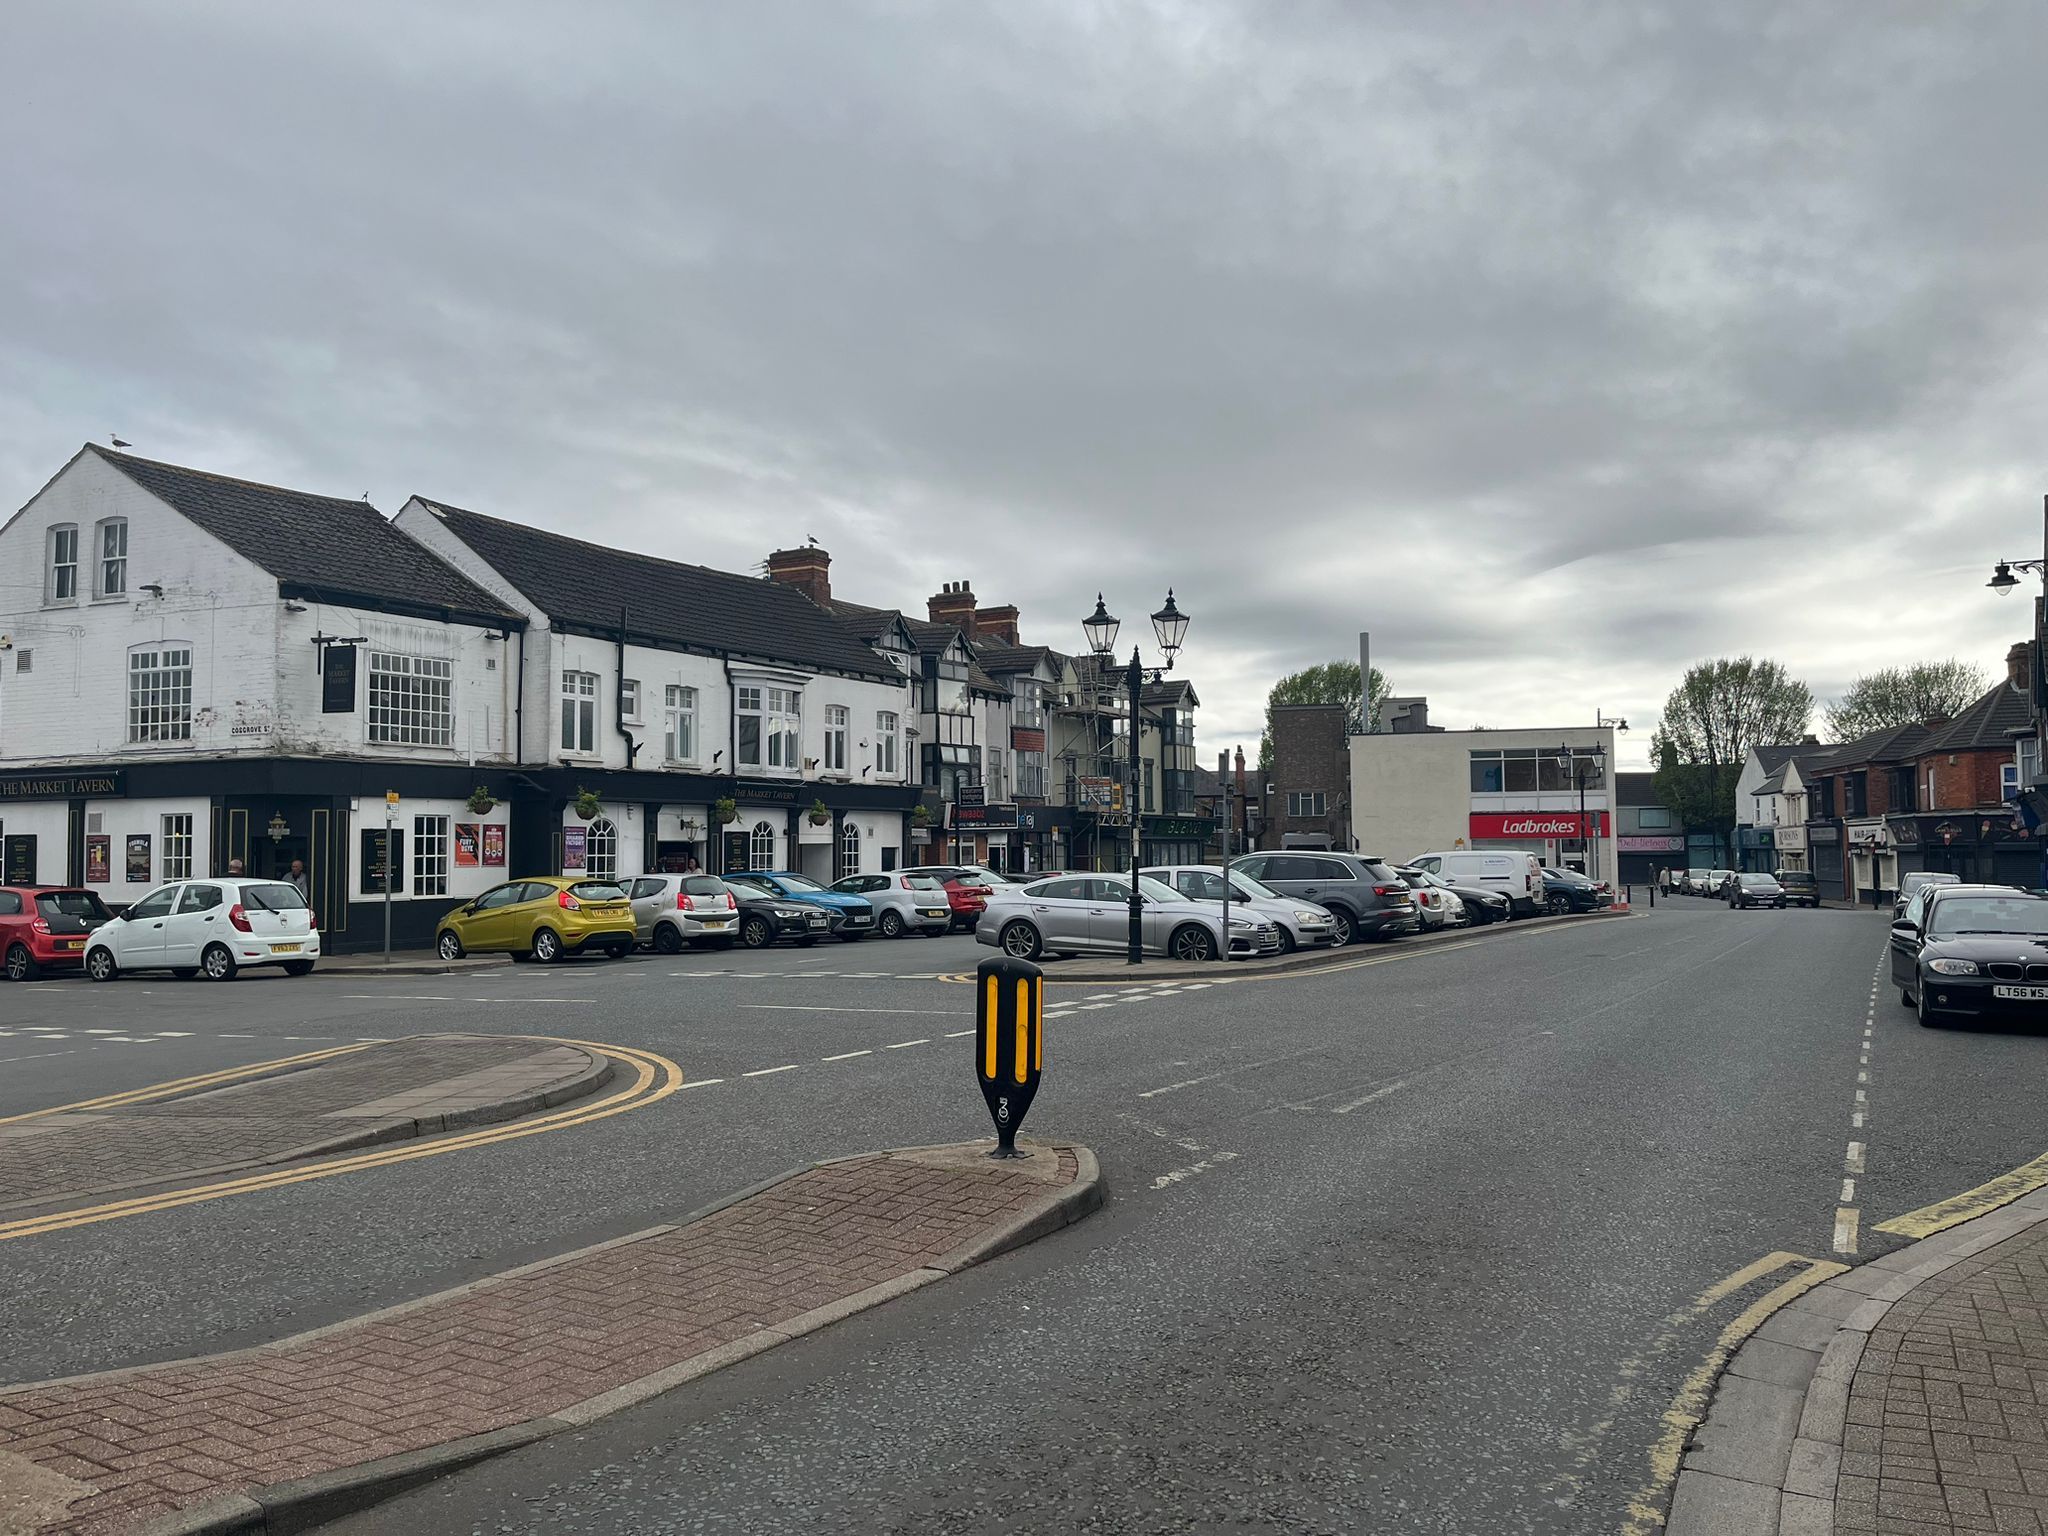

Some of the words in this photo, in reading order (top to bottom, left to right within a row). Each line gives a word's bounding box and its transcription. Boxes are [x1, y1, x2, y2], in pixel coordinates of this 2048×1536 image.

[231, 726, 262, 734] COSGROVE
[20, 780, 66, 795] MARKET
[68, 778, 115, 792] TAVERN
[746, 789, 771, 799] MARKET
[772, 790, 796, 799] TAVERN
[1503, 820, 1575, 834] Ladbrokes
[1998, 987, 2027, 997] LT56
